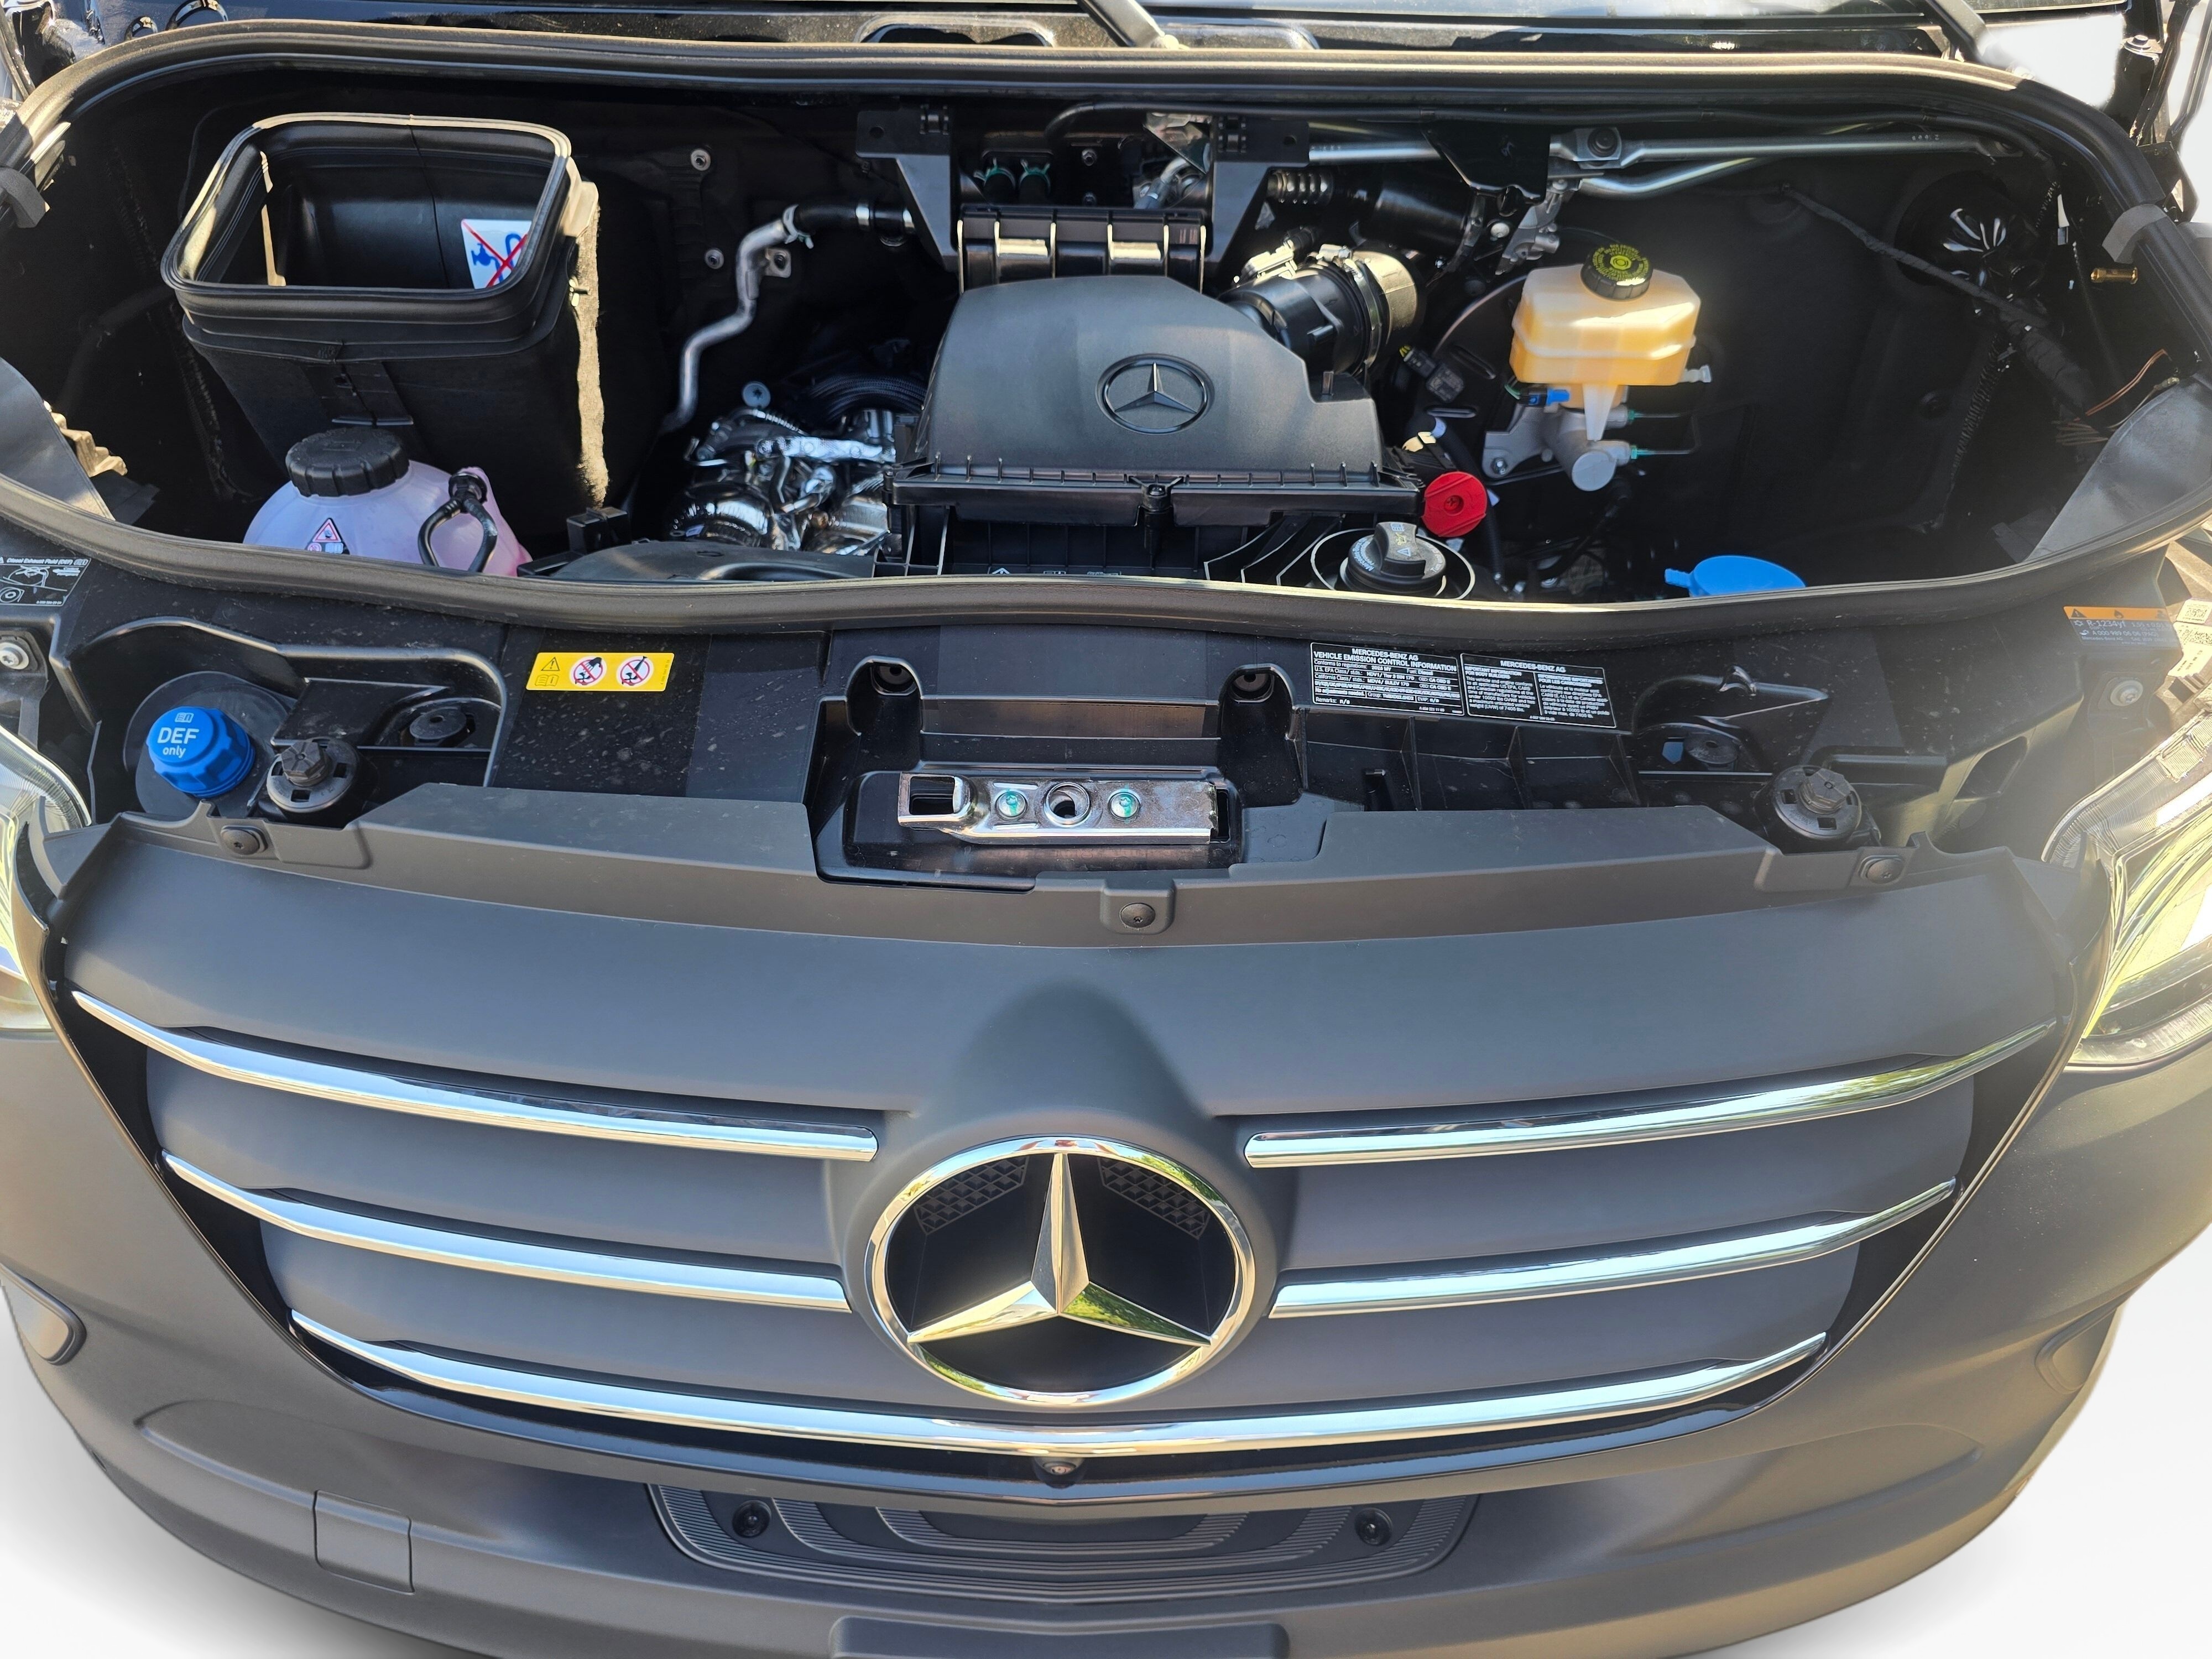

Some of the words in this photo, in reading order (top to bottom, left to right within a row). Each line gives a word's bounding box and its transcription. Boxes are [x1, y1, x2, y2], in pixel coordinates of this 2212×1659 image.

[1352, 648, 1407, 660] MERCEDES-BENZ
[1313, 651, 1343, 660] VEHICLE
[1343, 654, 1376, 664] EMISSION
[1378, 658, 1410, 667] CONTROL
[1411, 661, 1457, 672] INFORMATION
[1500, 660, 1556, 672] MERCEDES-BENZ
[157, 727, 199, 744] DEF
[163, 745, 186, 759] only
